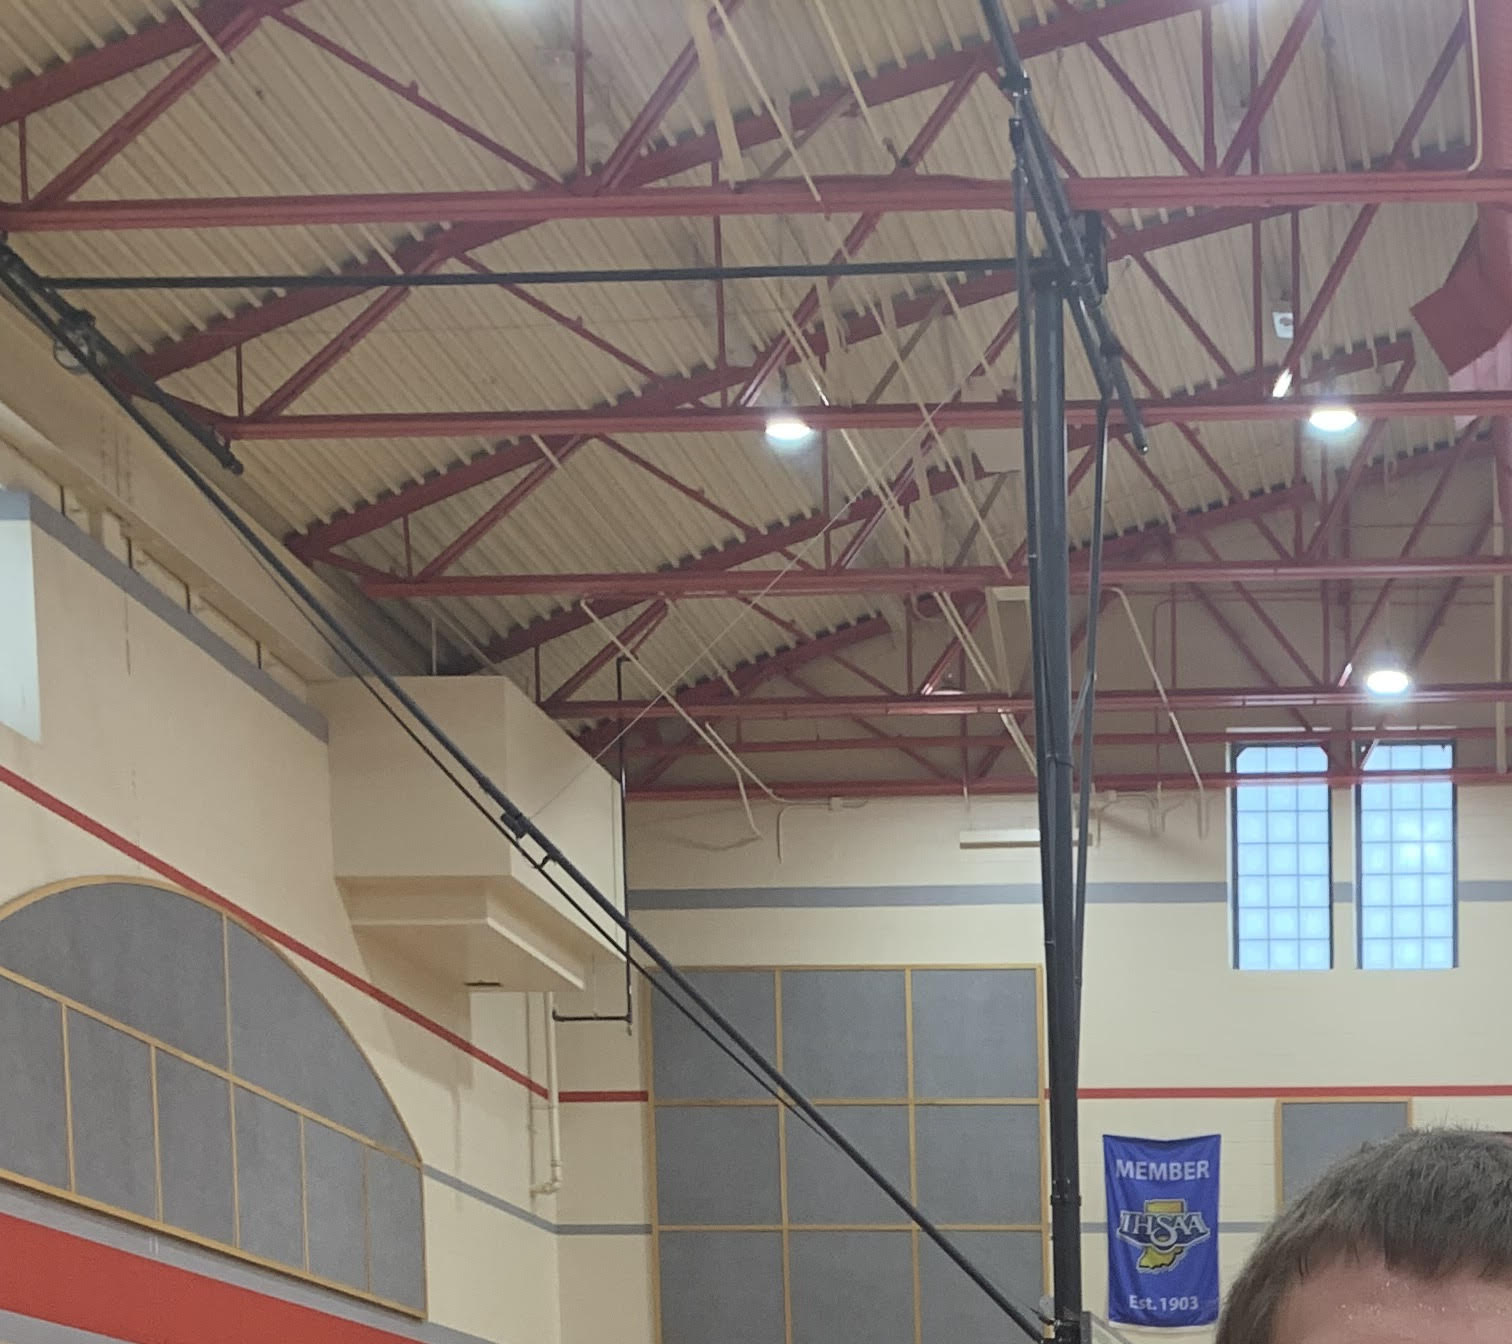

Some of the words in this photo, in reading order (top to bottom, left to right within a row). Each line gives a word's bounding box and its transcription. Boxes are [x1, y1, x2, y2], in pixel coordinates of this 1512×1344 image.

[1115, 1159, 1210, 1181] MEMBER
[1120, 1211, 1205, 1248] IHSAA
[1128, 1294, 1158, 1311] Est.
[1160, 1295, 1199, 1311] 1903
